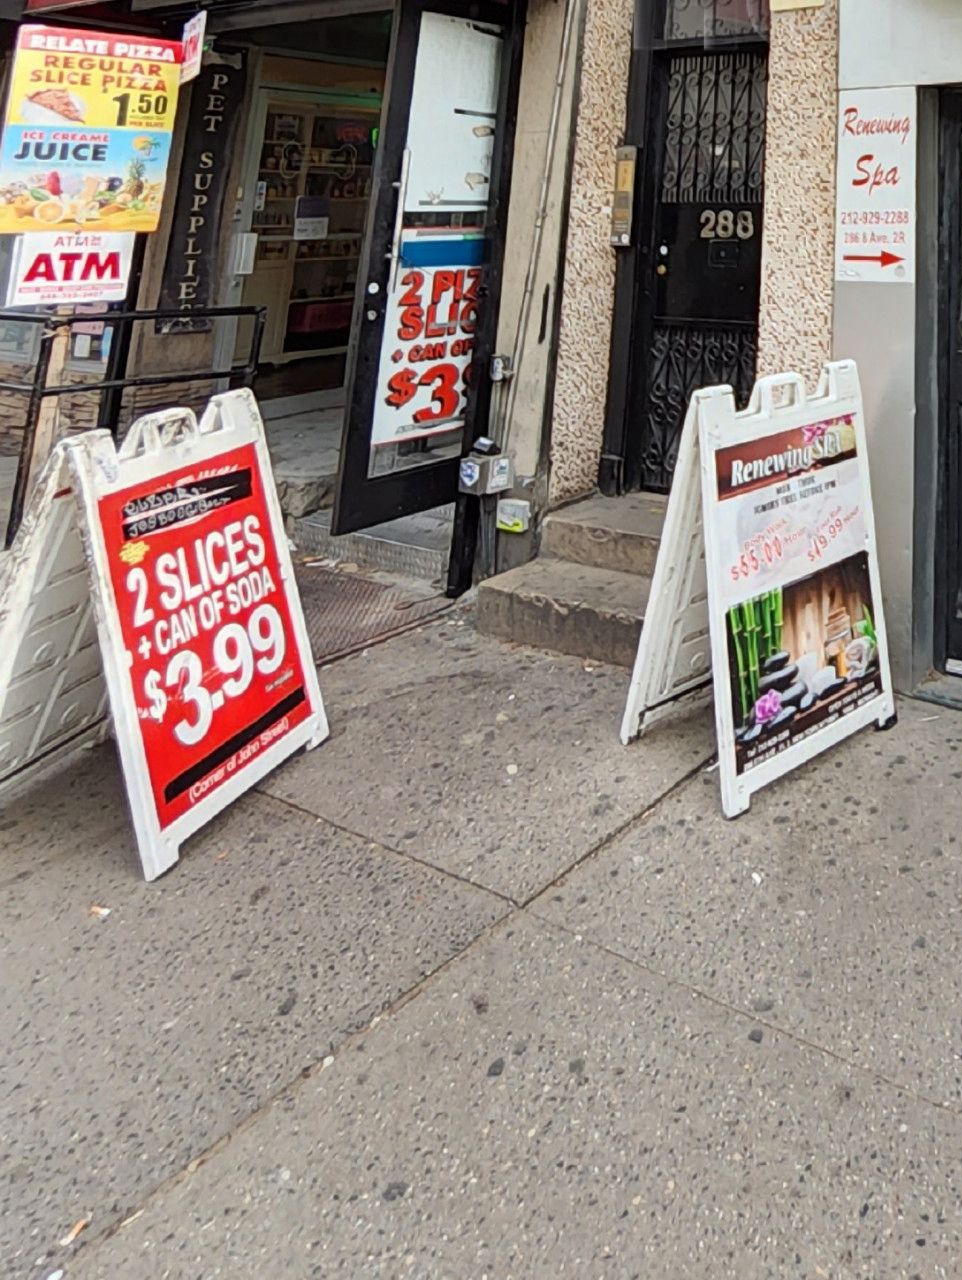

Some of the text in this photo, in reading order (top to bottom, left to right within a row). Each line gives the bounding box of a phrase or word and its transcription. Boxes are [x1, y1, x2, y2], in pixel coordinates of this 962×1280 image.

[30, 34, 176, 62] RELATE PIZZA
[30, 69, 168, 93] SLICE PIZZA
[44, 55, 162, 77] REGULAR
[112, 92, 168, 127] 1.50
[203, 73, 229, 132] PET
[842, 107, 911, 145] Renewing
[14, 141, 108, 162] JUICE
[852, 153, 900, 197] Spa
[700, 209, 754, 239] 288
[841, 211, 909, 225] 212-929-2288
[22, 252, 121, 282] ATM
[399, 270, 425, 307] 2
[408, 341, 447, 363] CAN
[730, 444, 812, 487] Renewing
[125, 566, 154, 628] 2
[155, 514, 267, 612] SLICES
[155, 605, 199, 657] CAN
[198, 591, 224, 632] OF
[228, 565, 276, 614] SODA
[142, 602, 287, 747] $3.99
